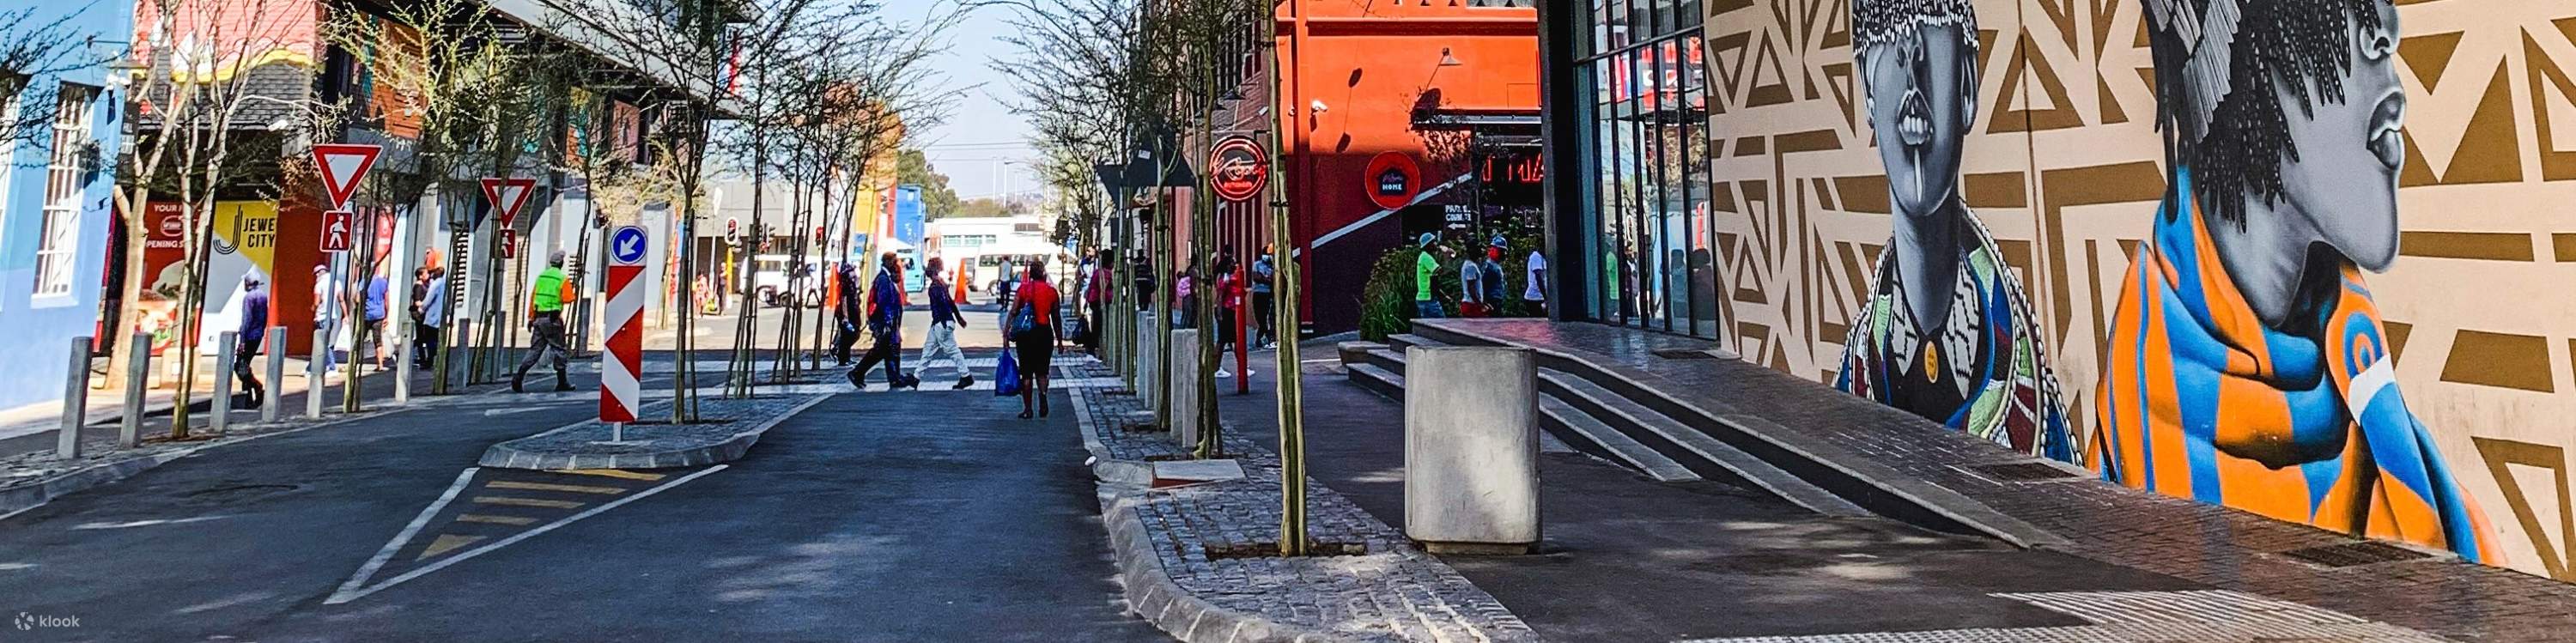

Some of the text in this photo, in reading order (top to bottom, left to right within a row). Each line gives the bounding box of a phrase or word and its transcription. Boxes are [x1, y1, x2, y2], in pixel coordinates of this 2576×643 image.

[243, 218, 276, 232] JEWE
[146, 240, 178, 248] PENING
[247, 234, 276, 248] CITY
